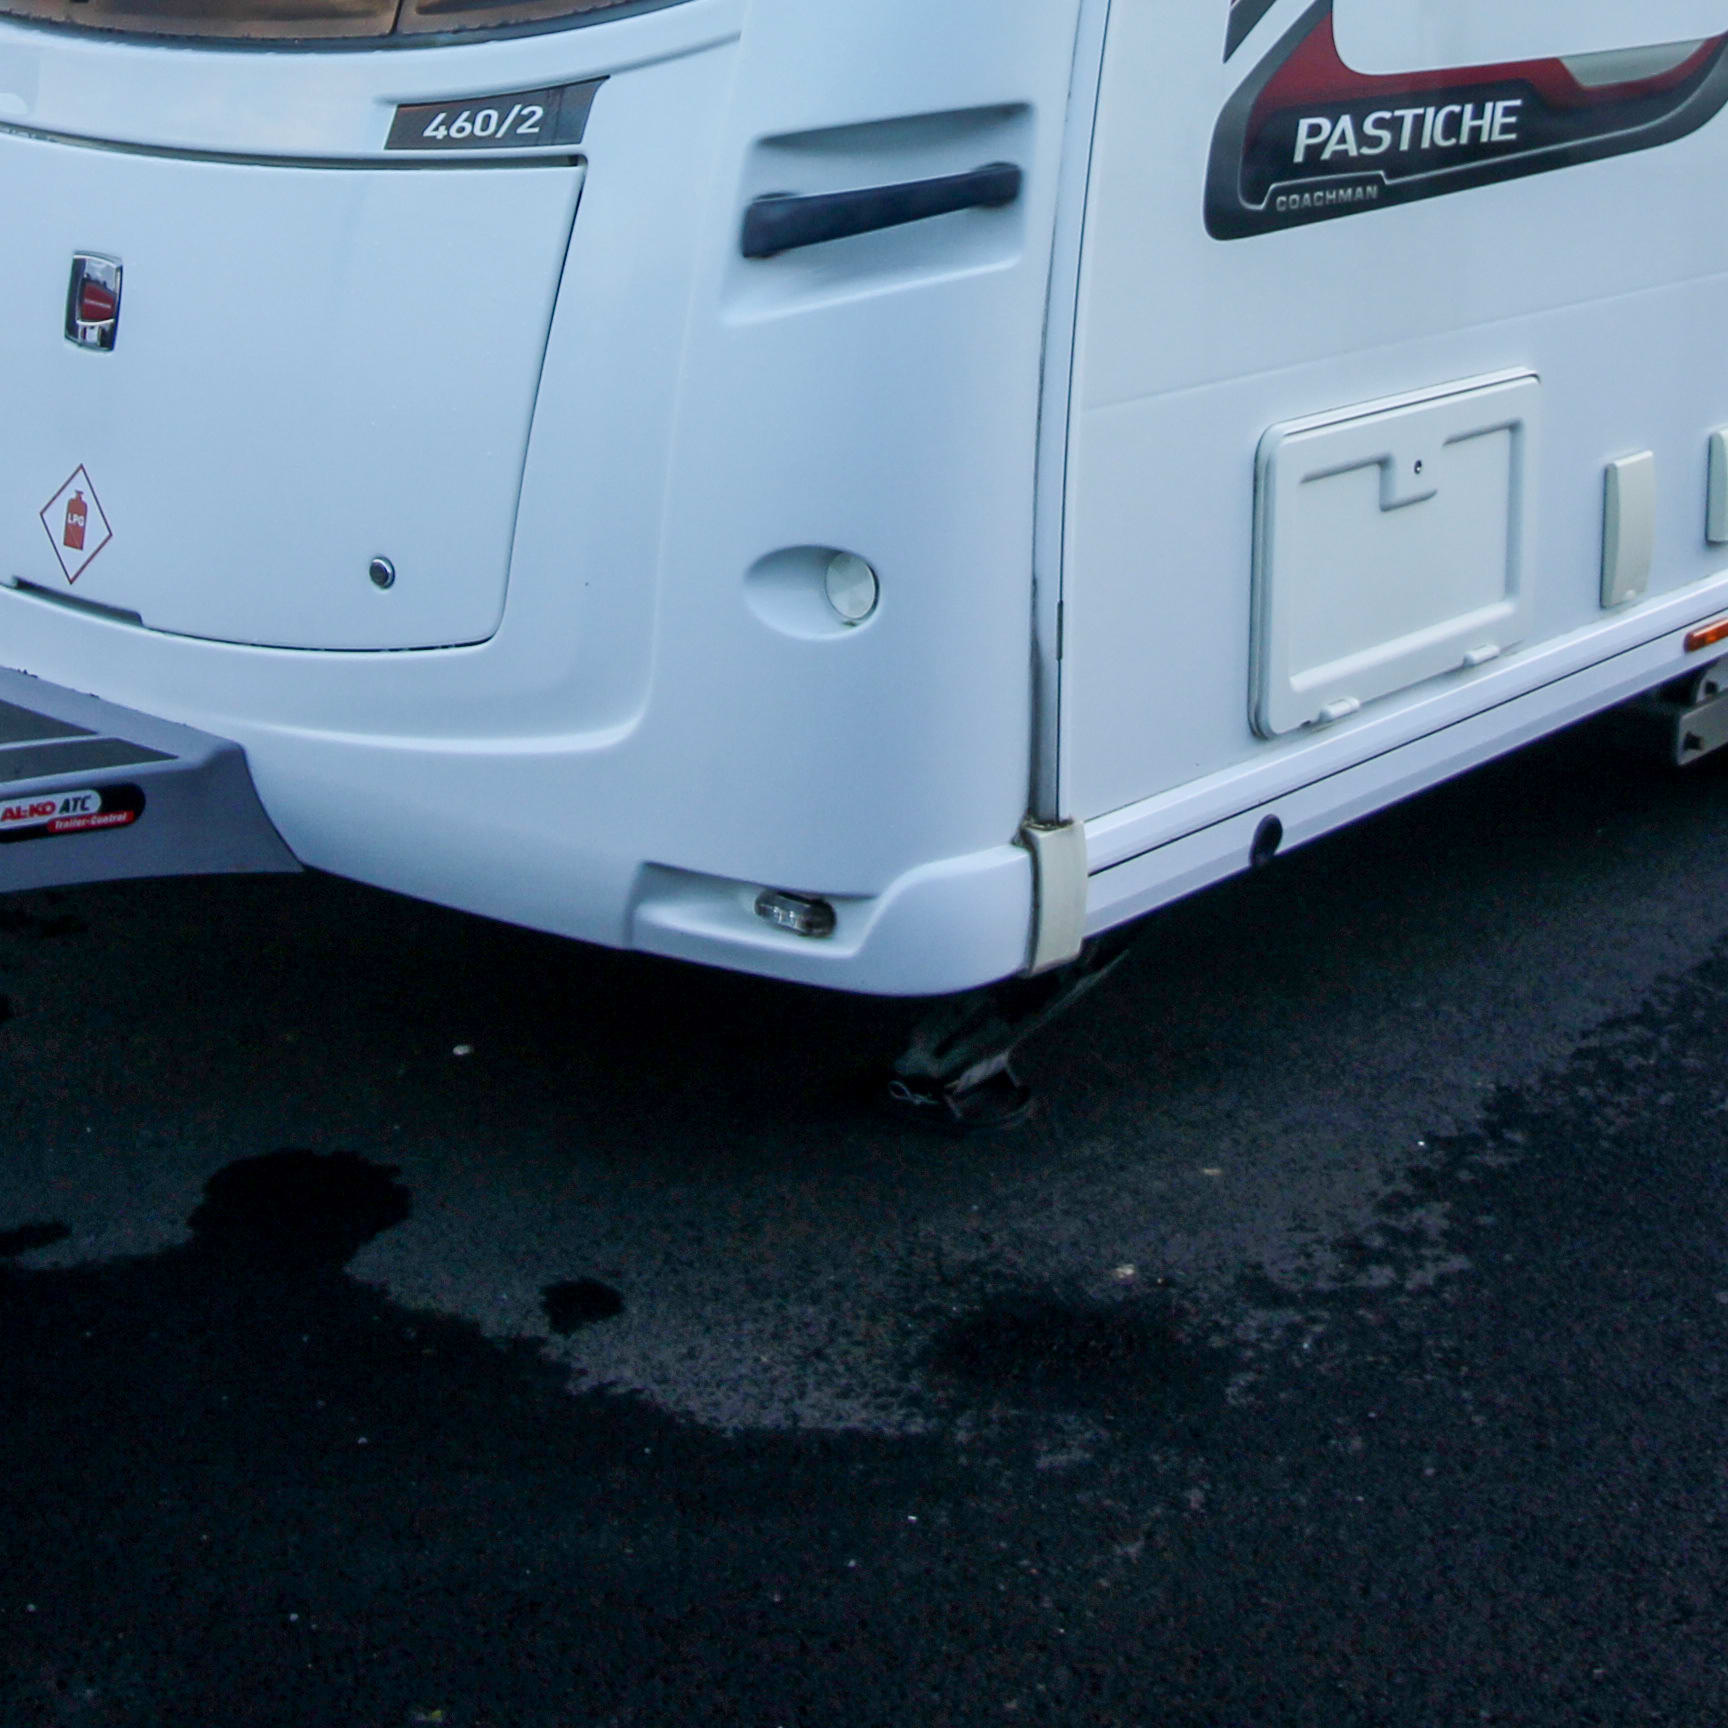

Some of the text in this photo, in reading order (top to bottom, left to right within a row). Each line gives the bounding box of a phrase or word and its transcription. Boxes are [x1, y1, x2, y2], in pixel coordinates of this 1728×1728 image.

[423, 104, 544, 139] 460/2
[1293, 99, 1522, 164] PASTICHE
[1276, 185, 1379, 212] COACHMAN
[68, 513, 85, 527] LPG
[0, 795, 92, 822] AL-KO ATC
